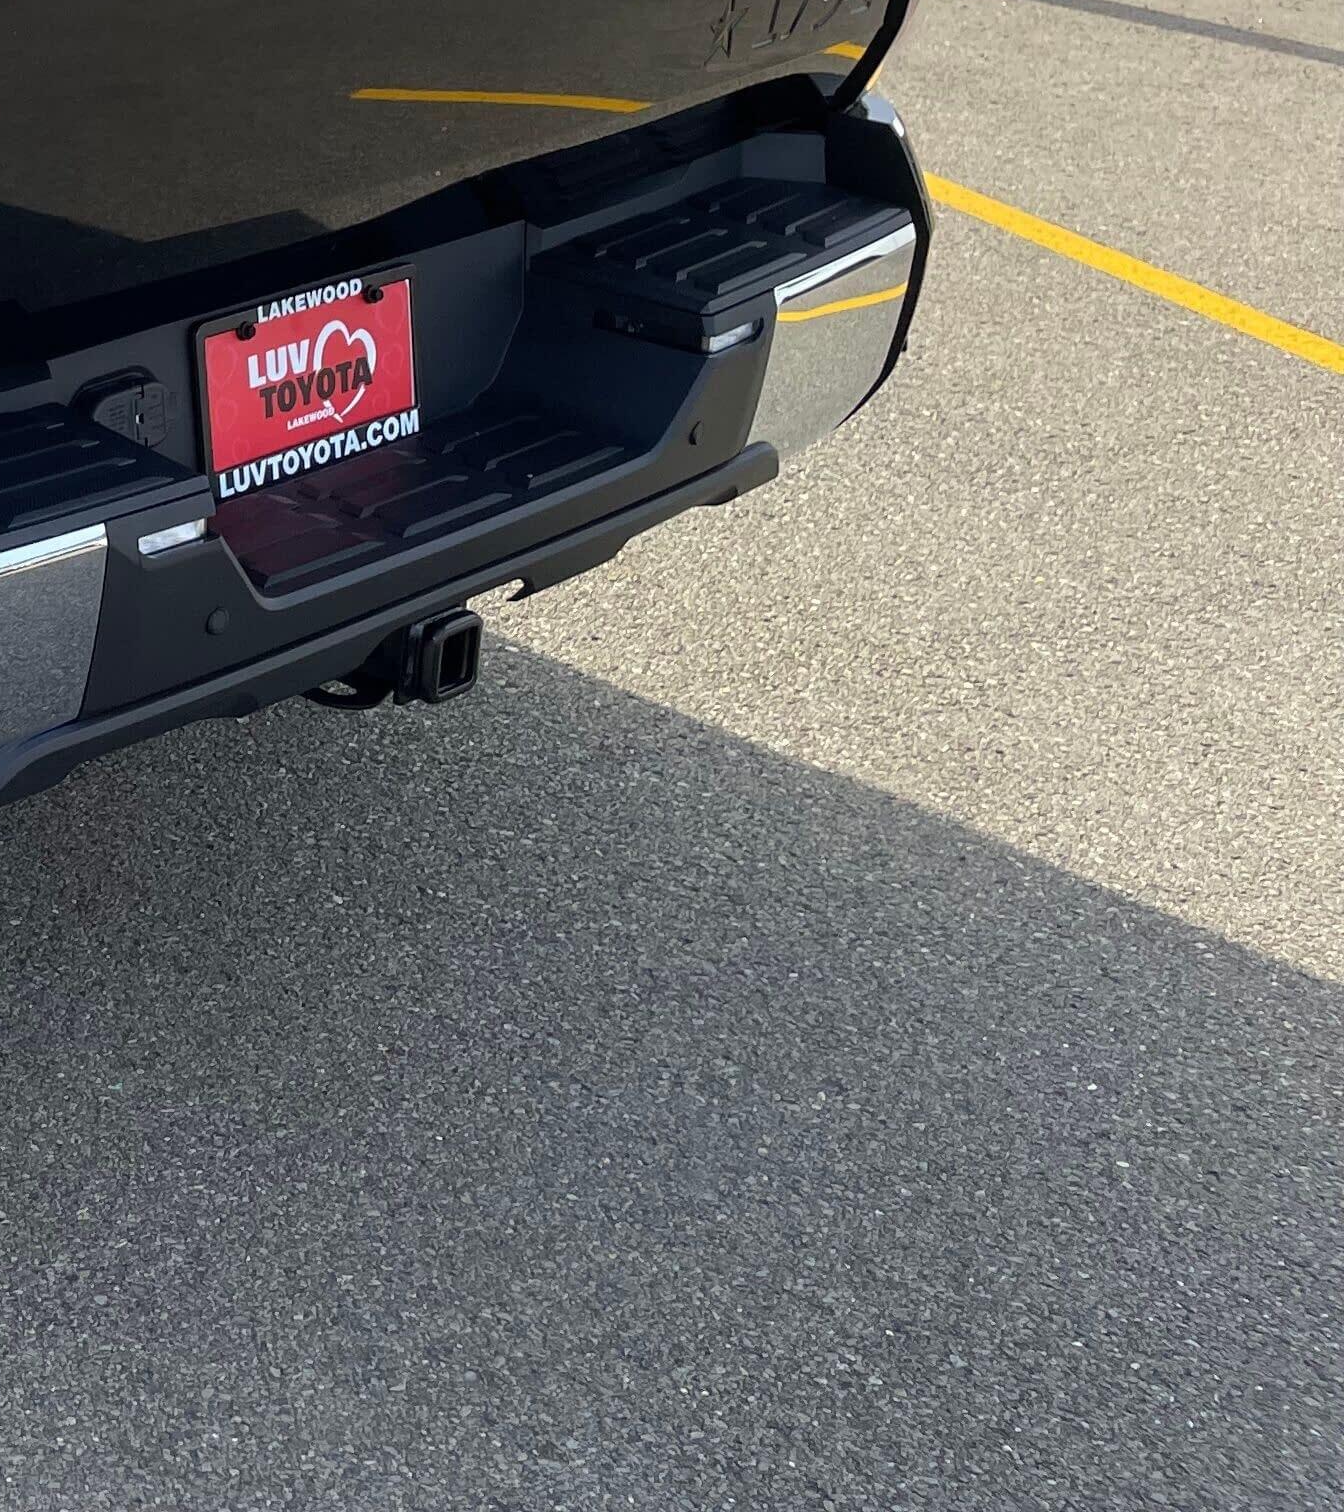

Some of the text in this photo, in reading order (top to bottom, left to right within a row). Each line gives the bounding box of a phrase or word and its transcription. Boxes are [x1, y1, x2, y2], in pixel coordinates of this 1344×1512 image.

[257, 278, 363, 323] LAKEWOOD
[247, 339, 311, 388] LUV
[260, 357, 373, 418] TOYOTA
[287, 407, 335, 430] LAKEWOOD
[219, 409, 420, 499] LUVTOYOTA.COM
